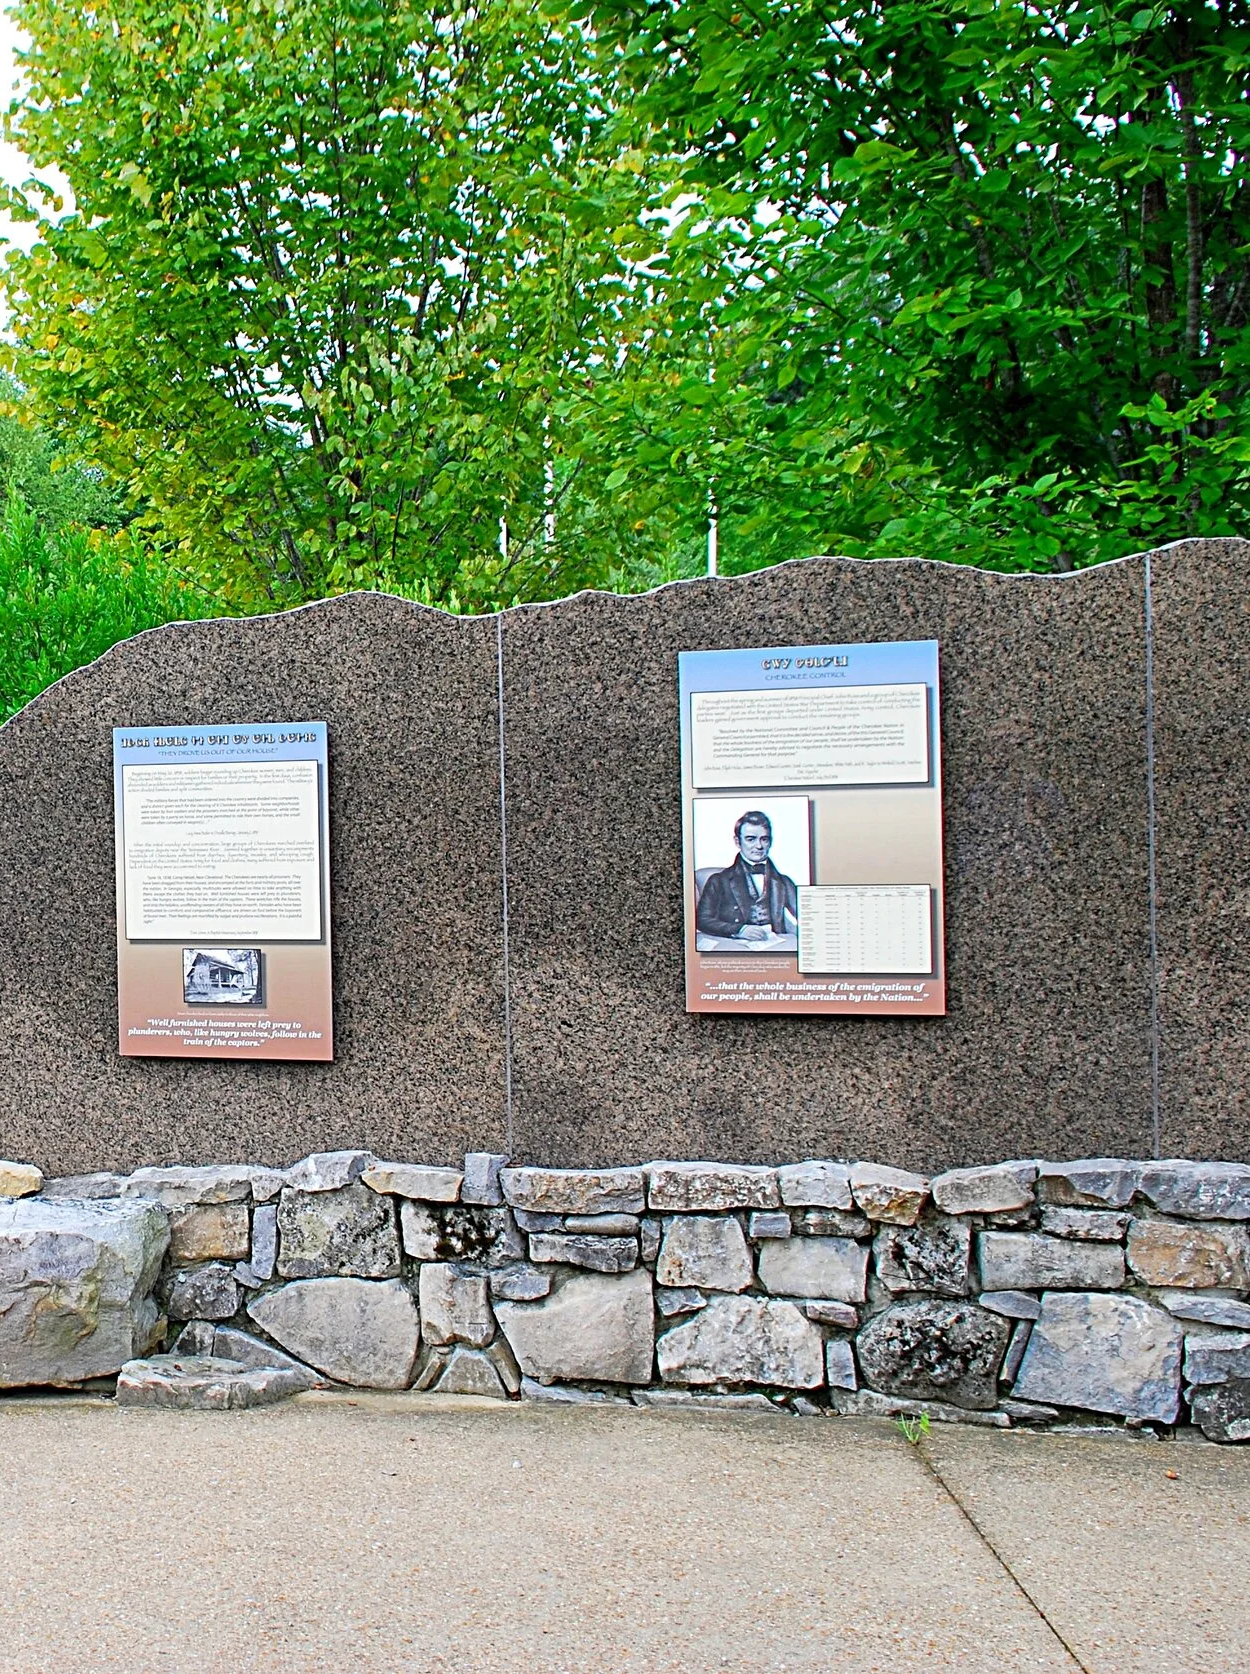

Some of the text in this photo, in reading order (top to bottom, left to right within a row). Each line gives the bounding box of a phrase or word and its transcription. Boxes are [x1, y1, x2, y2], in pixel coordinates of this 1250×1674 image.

[765, 671, 846, 681] CHEROKEE CONTROL
[739, 982, 754, 990] the
[755, 982, 785, 991] whole
[786, 982, 827, 991] business
[827, 982, 839, 993] of
[840, 982, 855, 991] the
[857, 982, 911, 993] emigration
[912, 983, 925, 993] of
[718, 992, 753, 1003] people,
[753, 992, 777, 1001] shall
[778, 992, 791, 1001] be
[791, 992, 847, 1001] undertaken
[848, 992, 861, 1003] by
[862, 993, 879, 1002] the
[168, 1018, 208, 1029] furnished
[208, 1020, 236, 1029] houses
[237, 1021, 257, 1029] were
[258, 1020, 272, 1030] left
[272, 1021, 291, 1030] prey
[292, 1021, 302, 1029] to
[127, 1028, 322, 1040] plunderers, who, like hungry wolves, follow in the
[183, 1037, 204, 1046] train
[204, 1037, 214, 1048] of
[214, 1038, 227, 1046] the
